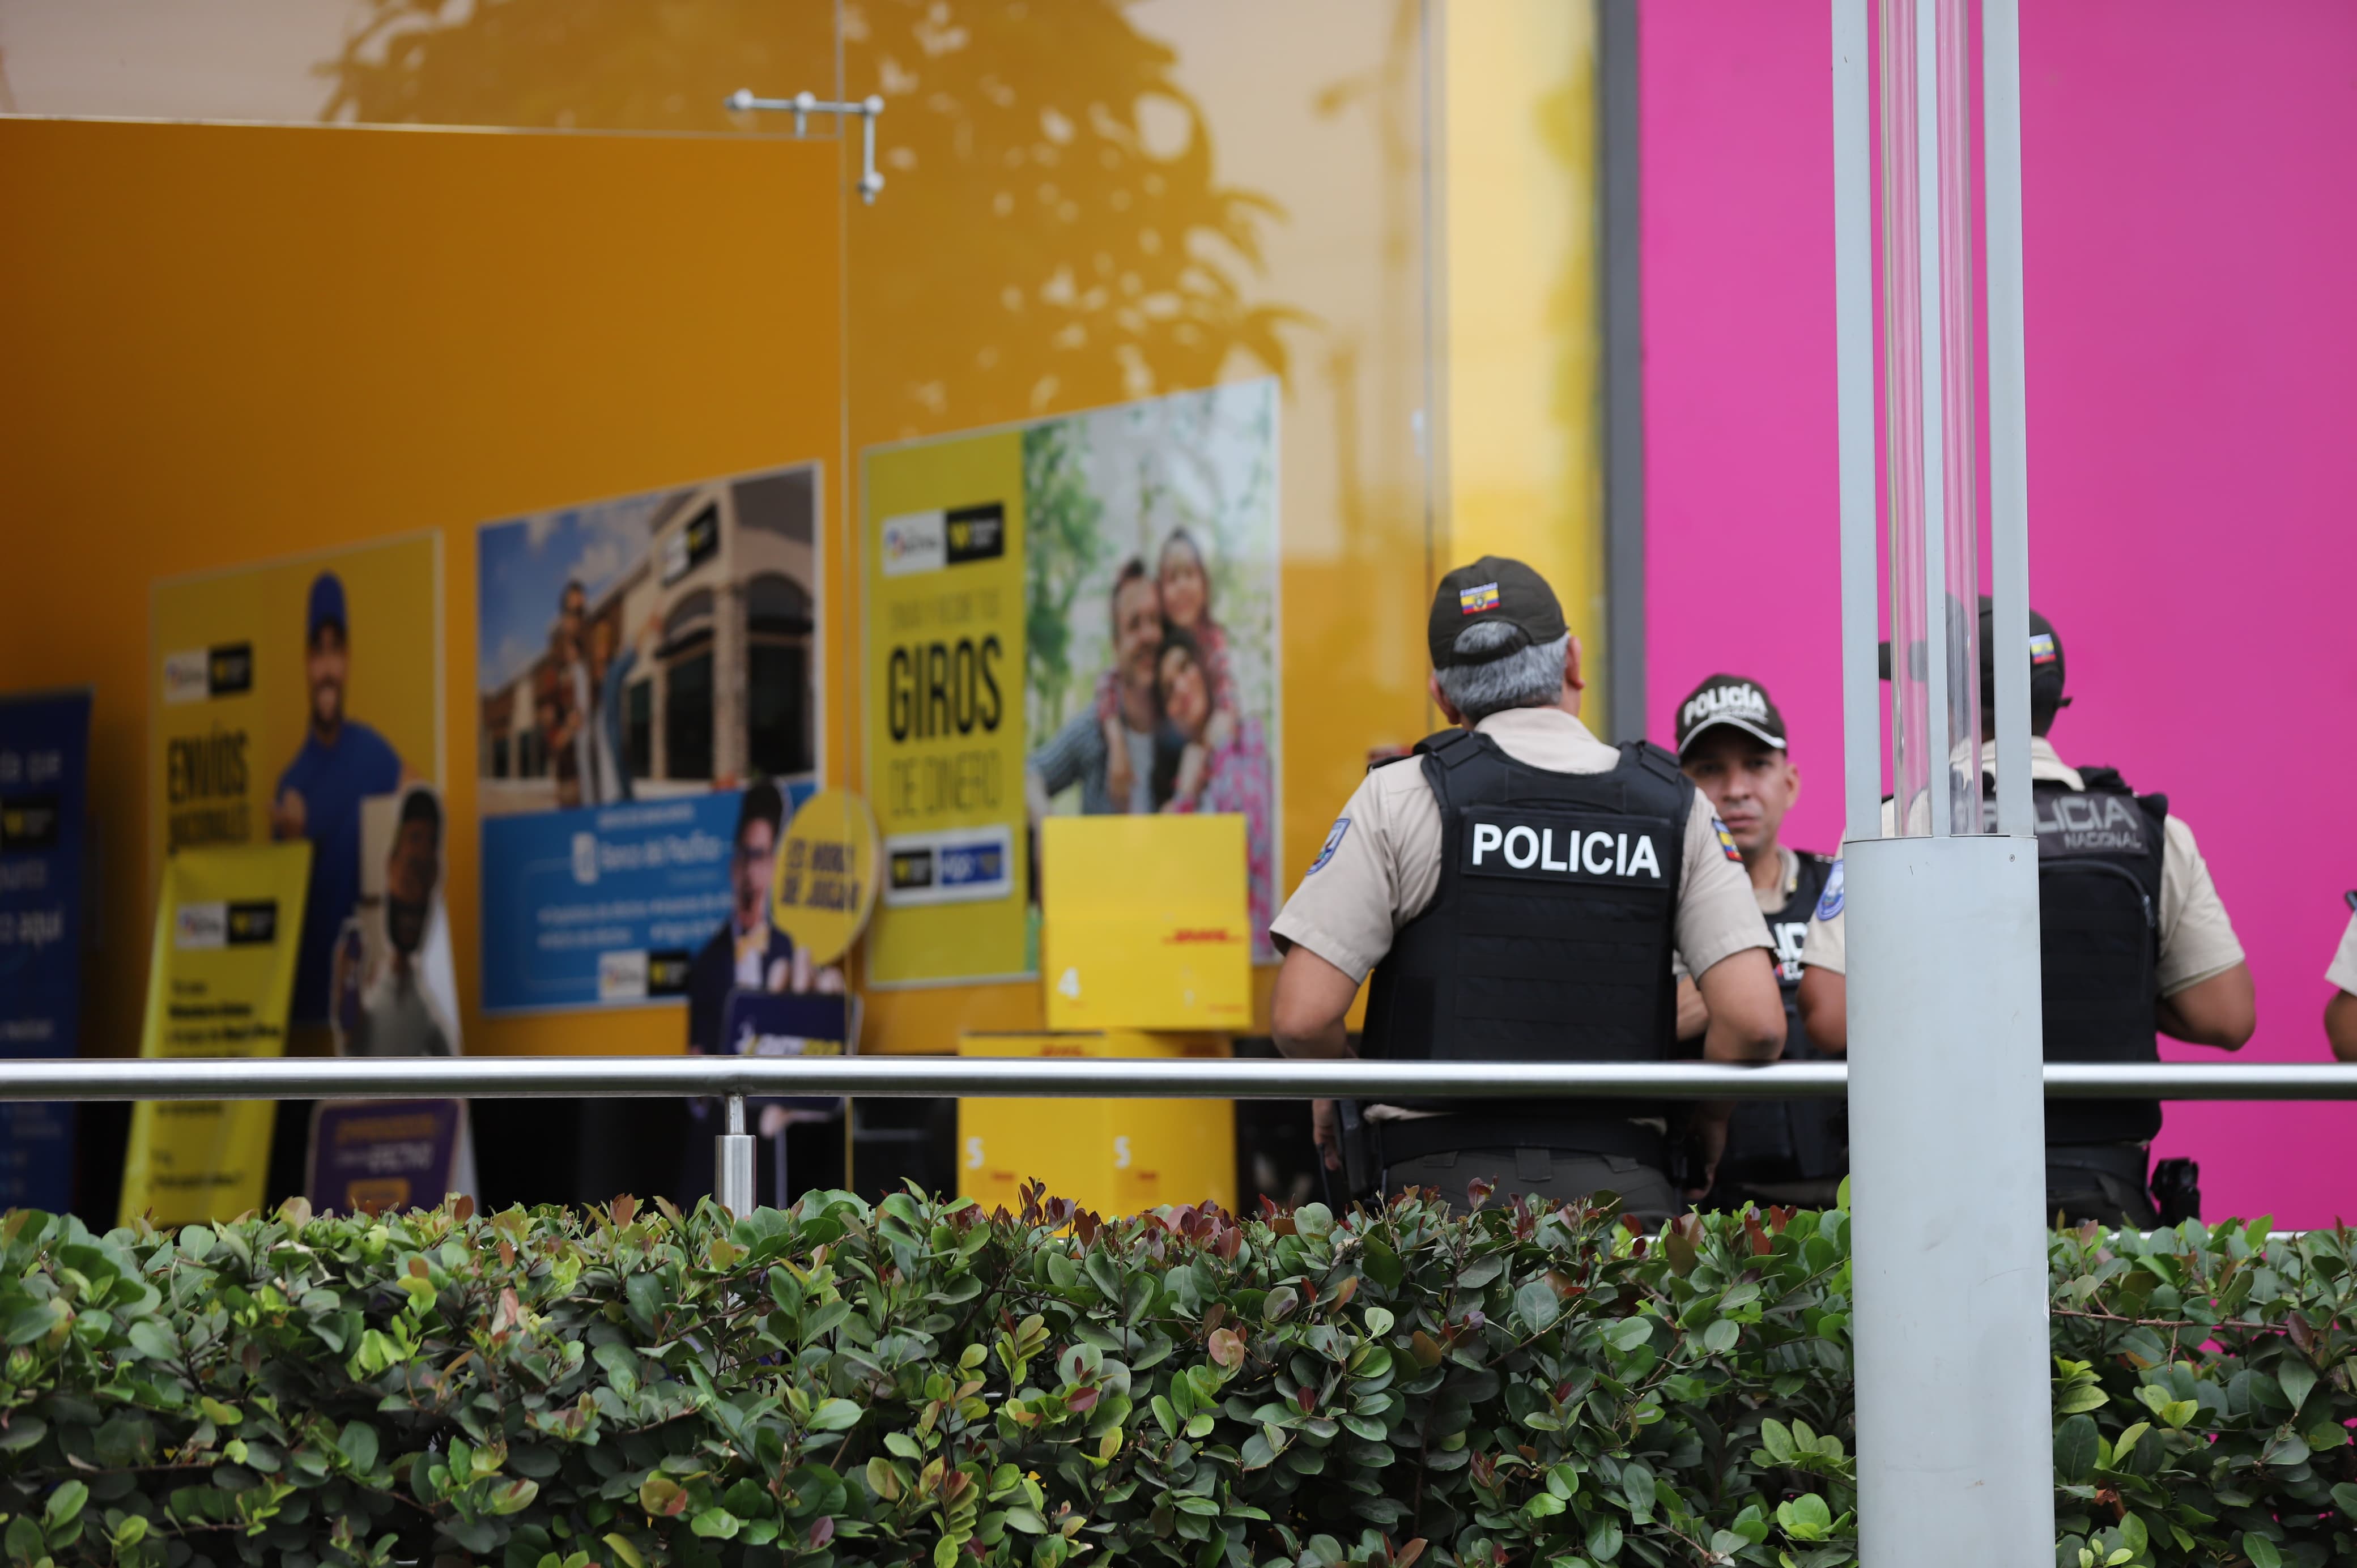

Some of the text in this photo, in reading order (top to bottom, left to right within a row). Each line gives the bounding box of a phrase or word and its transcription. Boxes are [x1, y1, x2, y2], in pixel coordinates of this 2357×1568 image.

[888, 634, 1002, 743] GIROS
[1684, 683, 1768, 726] POLICÍA
[168, 722, 249, 803] ENVÍOS
[890, 749, 1003, 819] DE DINERO
[1472, 823, 1661, 879] POLICIA
[2064, 831, 2142, 849] NACIONAL
[1057, 966, 1082, 999] 4
[965, 1136, 985, 1169] 5
[1113, 1135, 1131, 1169] 5
